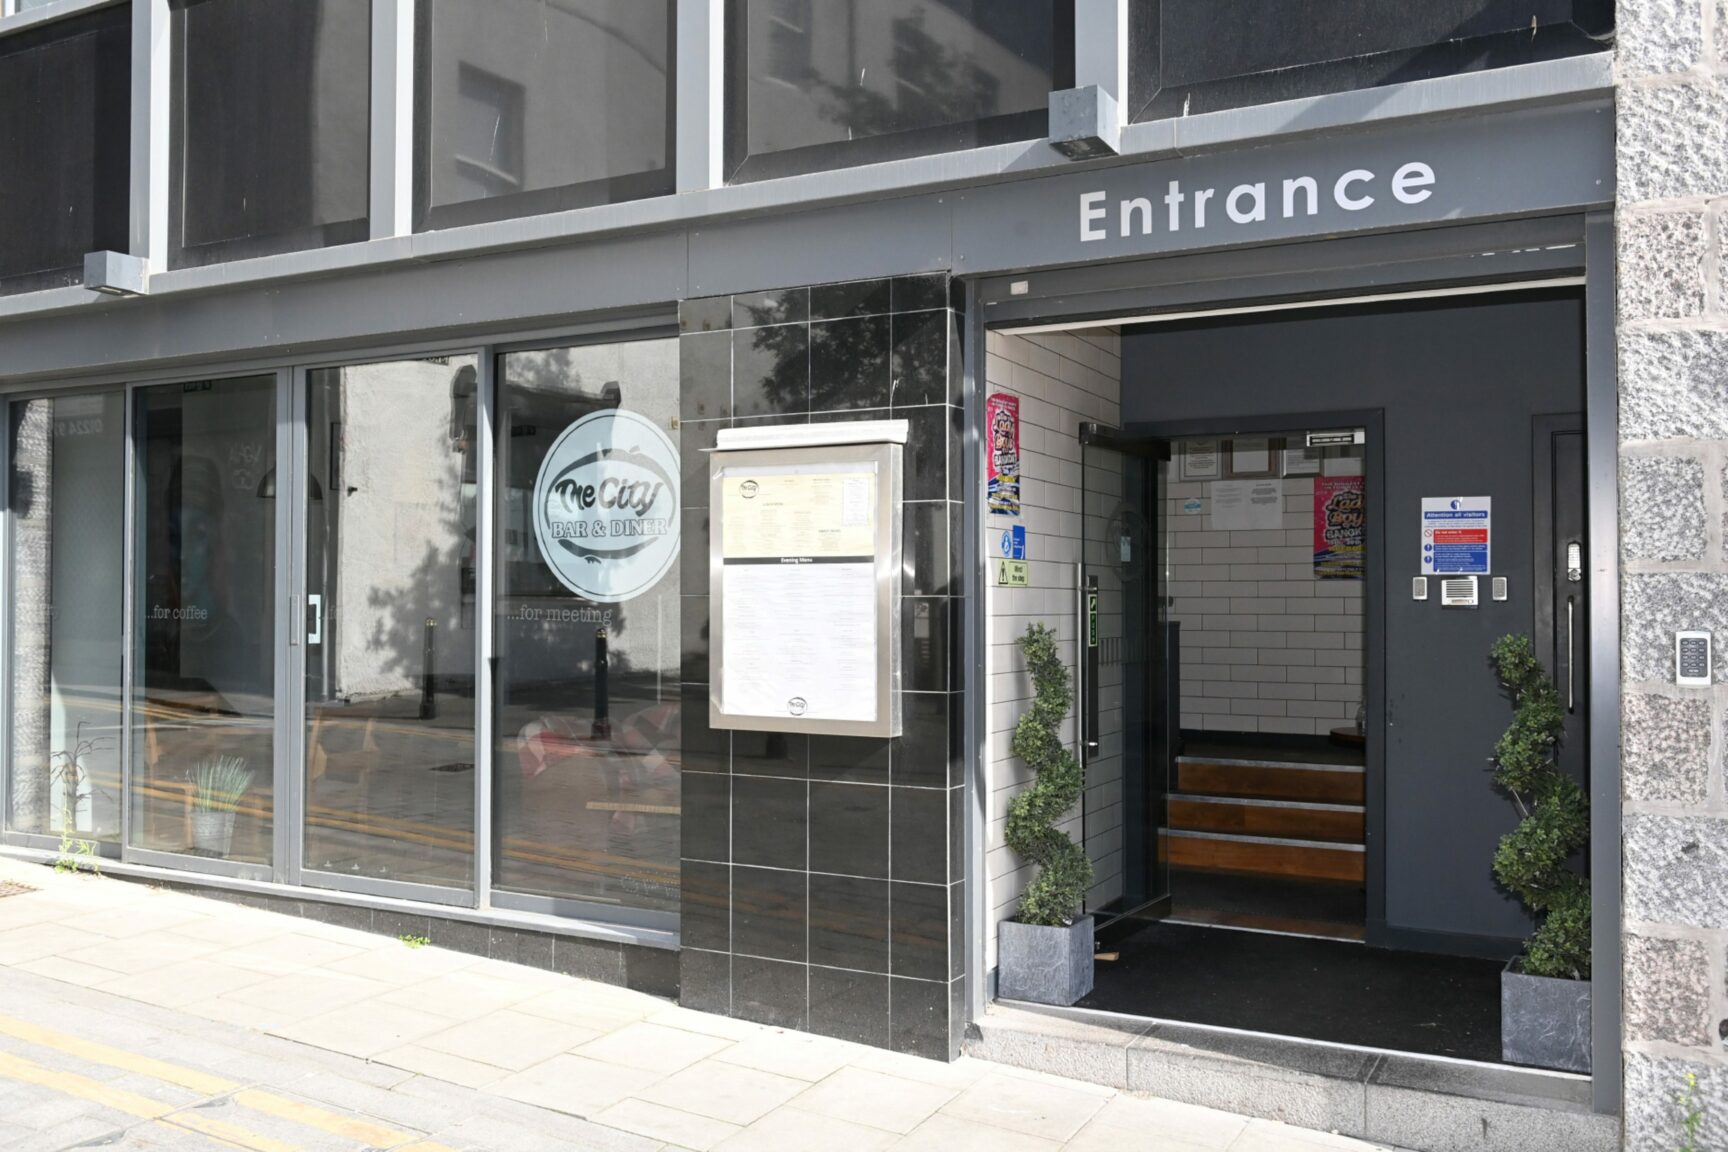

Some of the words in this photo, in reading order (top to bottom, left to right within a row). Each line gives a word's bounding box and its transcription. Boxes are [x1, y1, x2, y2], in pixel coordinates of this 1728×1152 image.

[1080, 161, 1436, 242] Entrance
[555, 478, 596, 513] The
[599, 477, 664, 517] City
[1326, 494, 1364, 511] Lad
[552, 520, 588, 539] BAR
[592, 519, 607, 537] &
[610, 518, 667, 537] DINER
[1328, 511, 1365, 528] Boy
[172, 604, 208, 620] coffee
[546, 606, 614, 627] meeting
